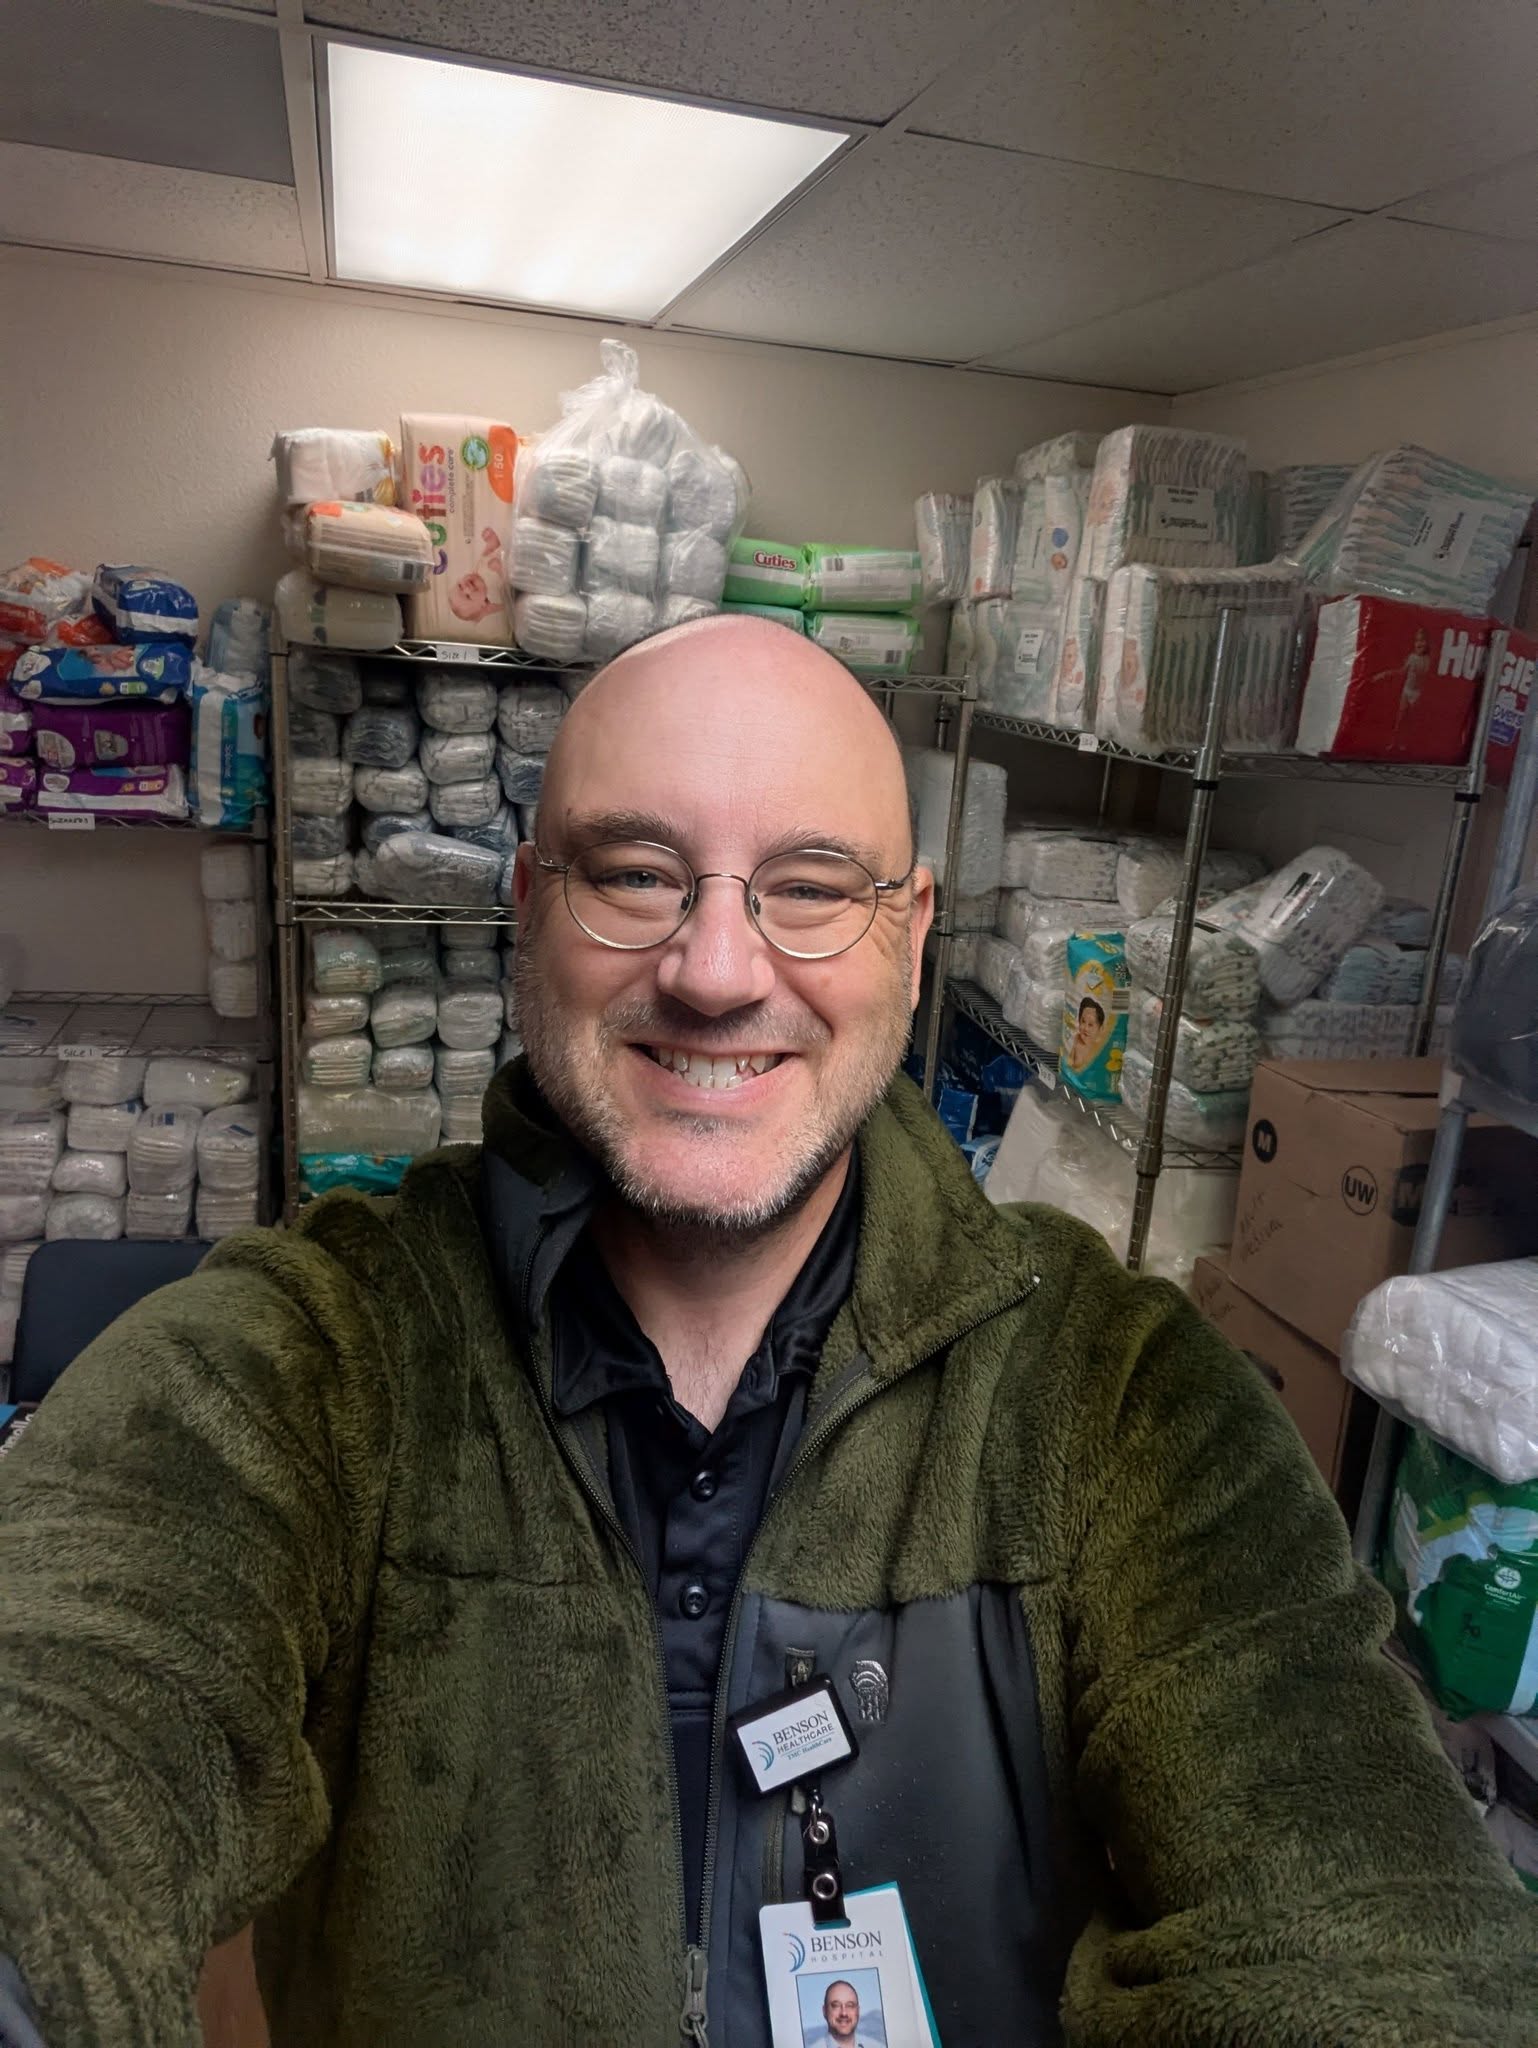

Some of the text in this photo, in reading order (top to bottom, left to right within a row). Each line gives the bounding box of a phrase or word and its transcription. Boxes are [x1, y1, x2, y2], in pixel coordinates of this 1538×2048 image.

[448, 471, 456, 513] complete
[754, 551, 796, 570] Cuties
[441, 650, 459, 660] Size
[1257, 1129, 1272, 1153] M
[1344, 1175, 1374, 1205] UW
[773, 1710, 829, 1744] BENSON
[777, 1723, 834, 1754] HEALTHCARE
[810, 1930, 883, 1952] BENSON
[811, 1950, 884, 1963] HOSPITAL
